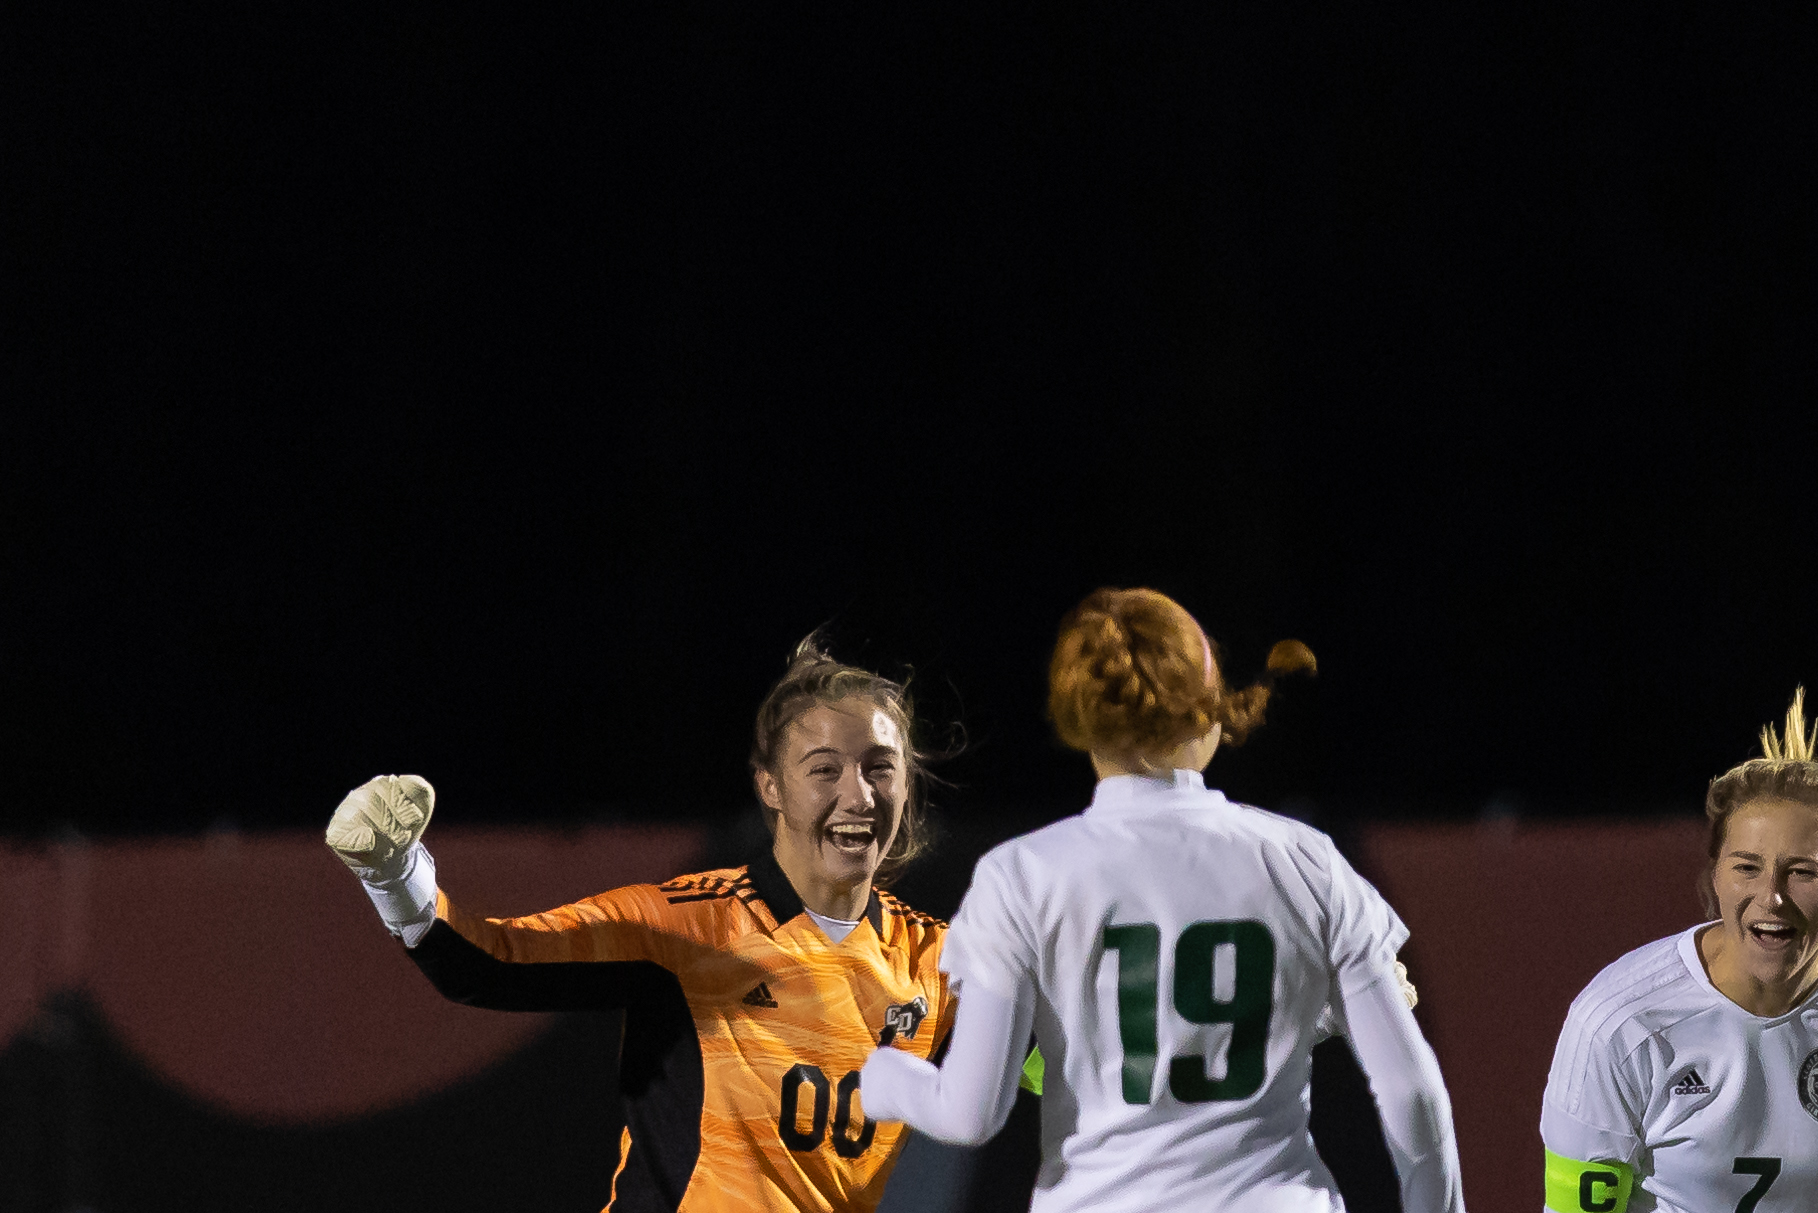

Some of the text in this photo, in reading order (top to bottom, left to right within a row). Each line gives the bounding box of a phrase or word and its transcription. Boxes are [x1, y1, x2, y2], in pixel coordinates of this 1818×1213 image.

[1103, 920, 1276, 1105] 19
[778, 1063, 877, 1159] 00
[1675, 1085, 1710, 1095] adidas
[1579, 1171, 1618, 1213] C
